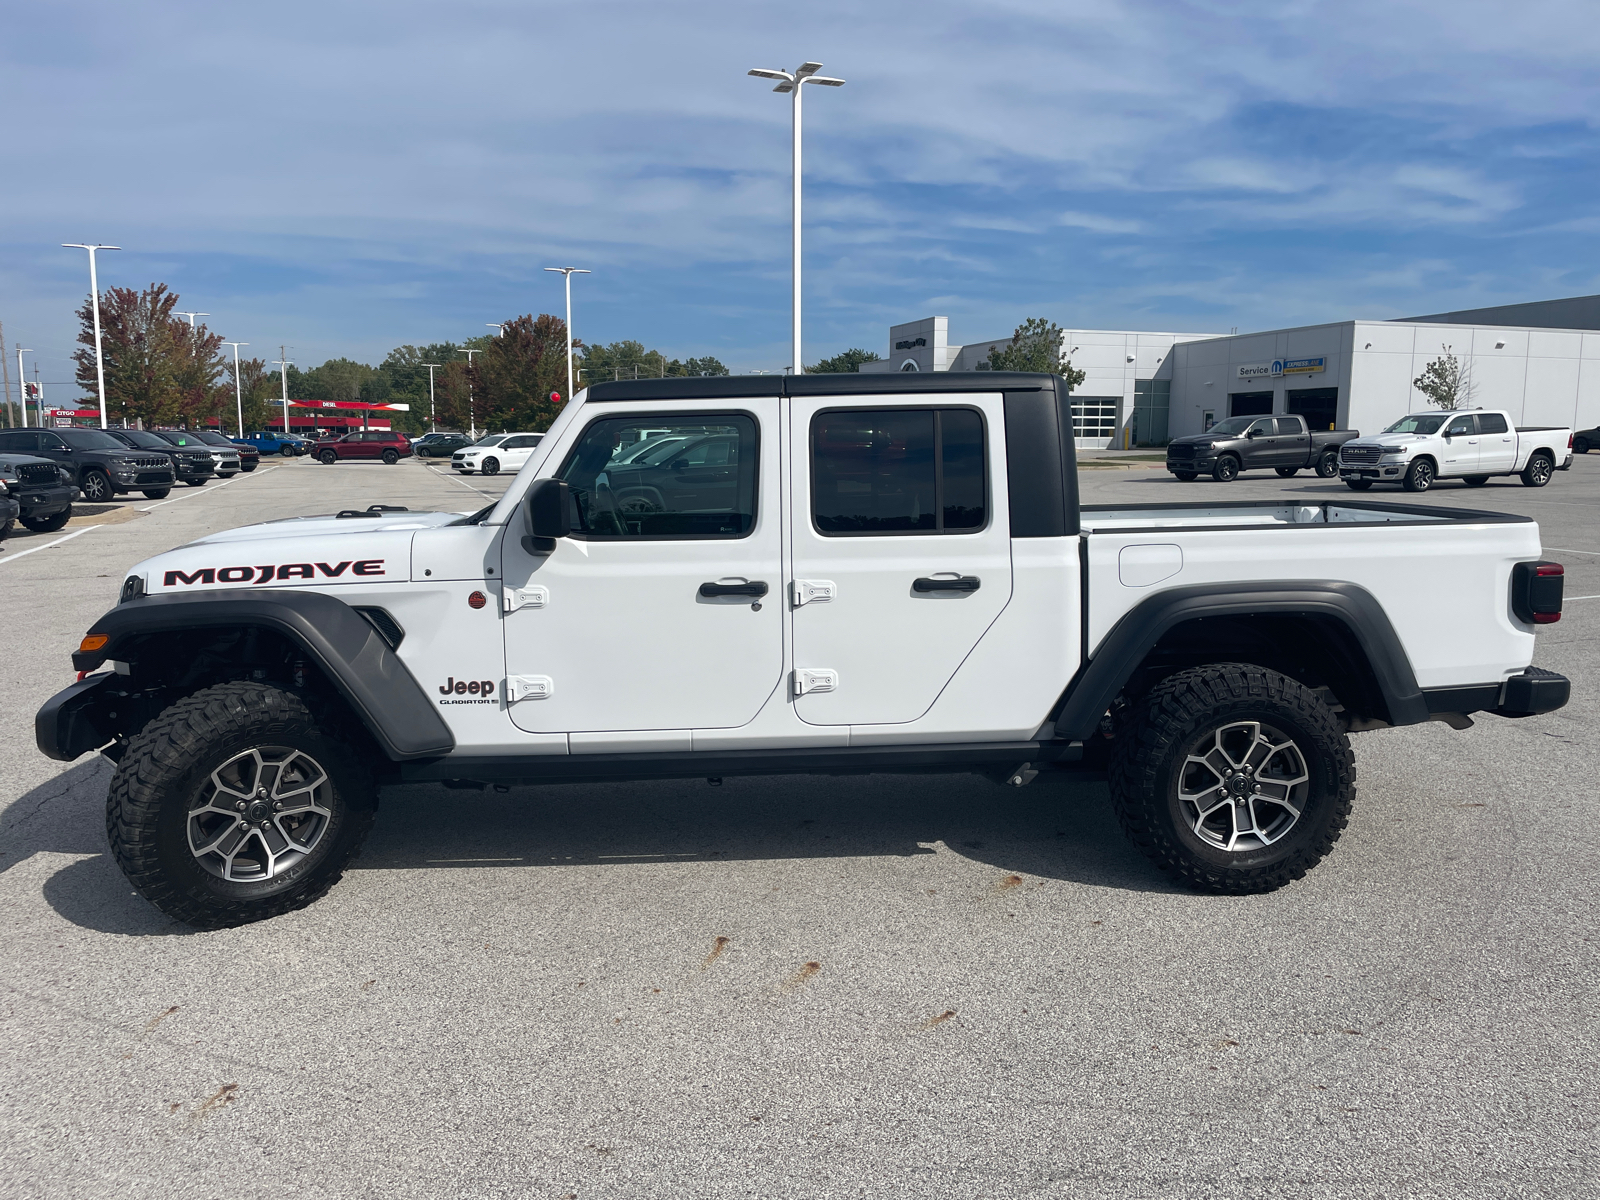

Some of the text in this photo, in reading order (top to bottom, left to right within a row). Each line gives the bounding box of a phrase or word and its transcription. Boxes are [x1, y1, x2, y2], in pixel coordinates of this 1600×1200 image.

[1240, 366, 1269, 376] Service
[163, 559, 385, 586] MOJAVE
[439, 677, 495, 698] Jeep
